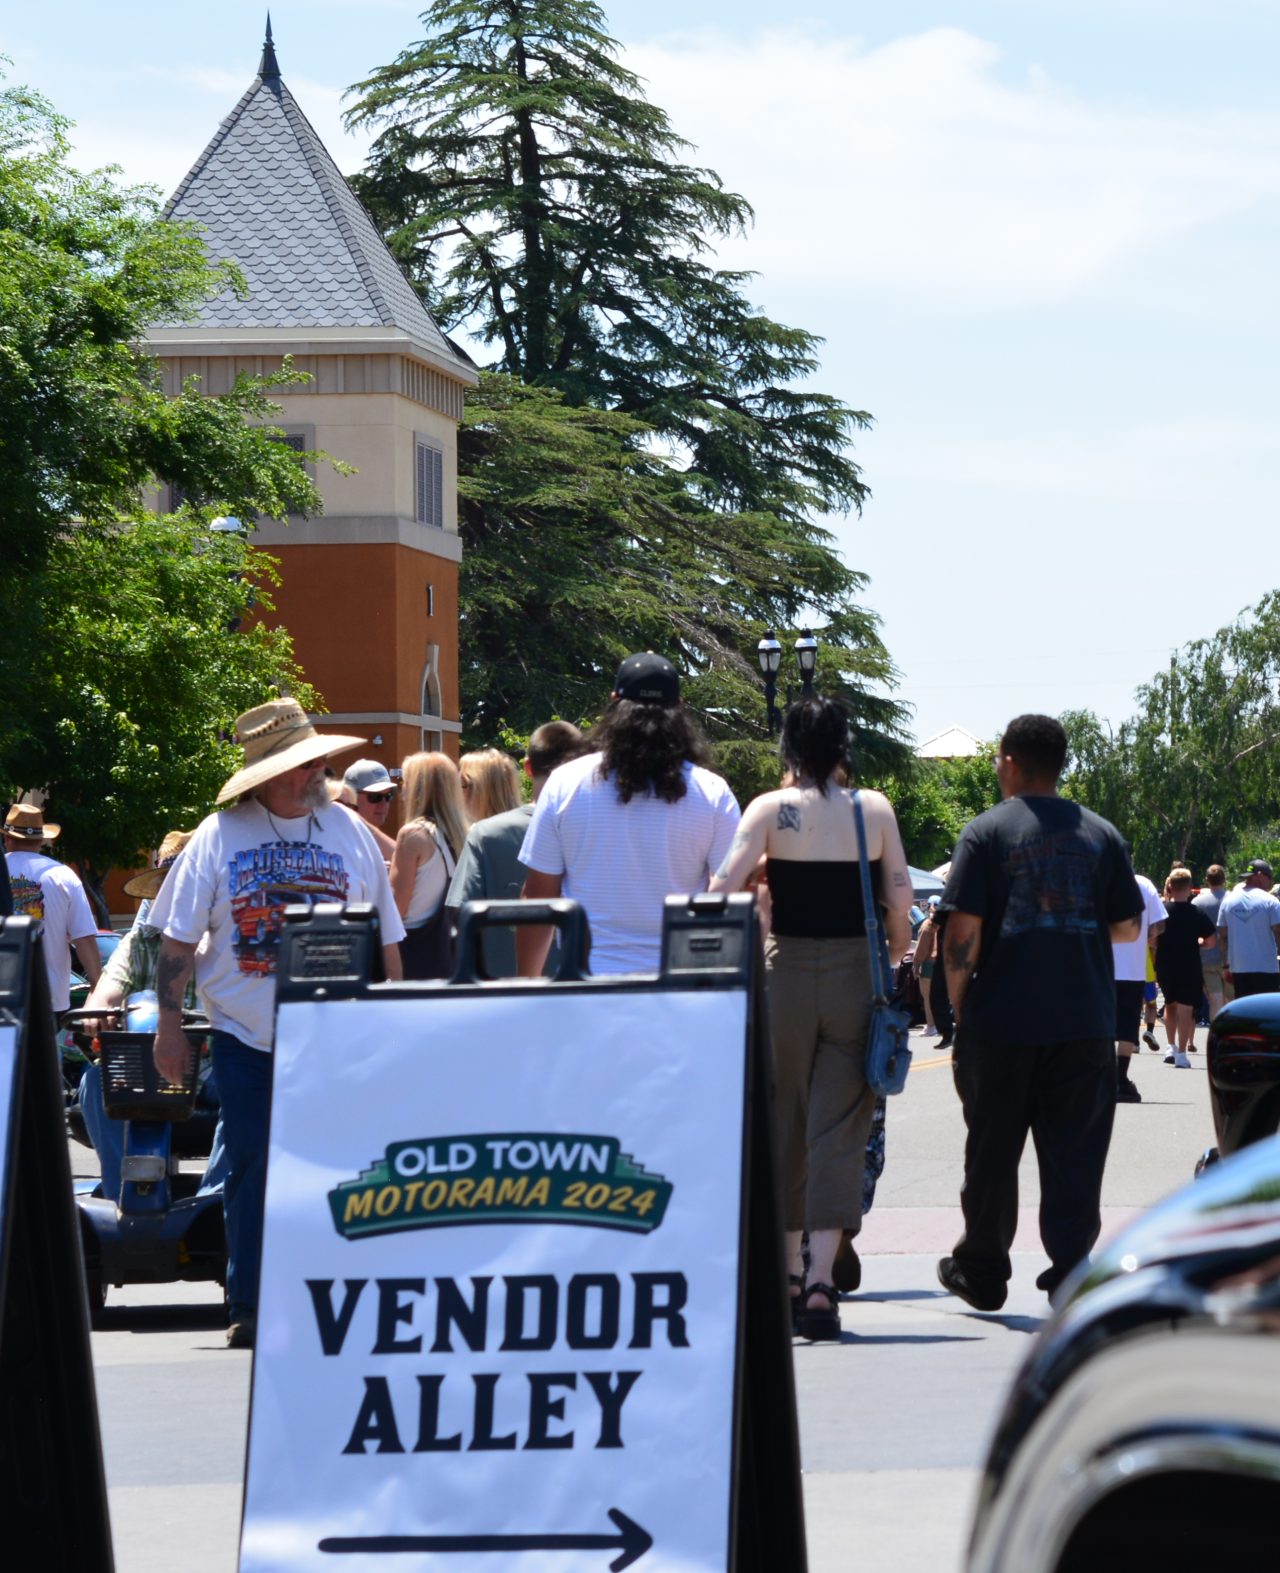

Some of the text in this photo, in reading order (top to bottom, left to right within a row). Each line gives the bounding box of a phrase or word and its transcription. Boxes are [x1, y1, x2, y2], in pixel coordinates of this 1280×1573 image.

[395, 1140, 610, 1177] OLD TOWN
[343, 1176, 657, 1223] MOTORAMA 2024
[304, 1271, 690, 1356] VENDOR
[341, 1370, 643, 1455] ALLEY
